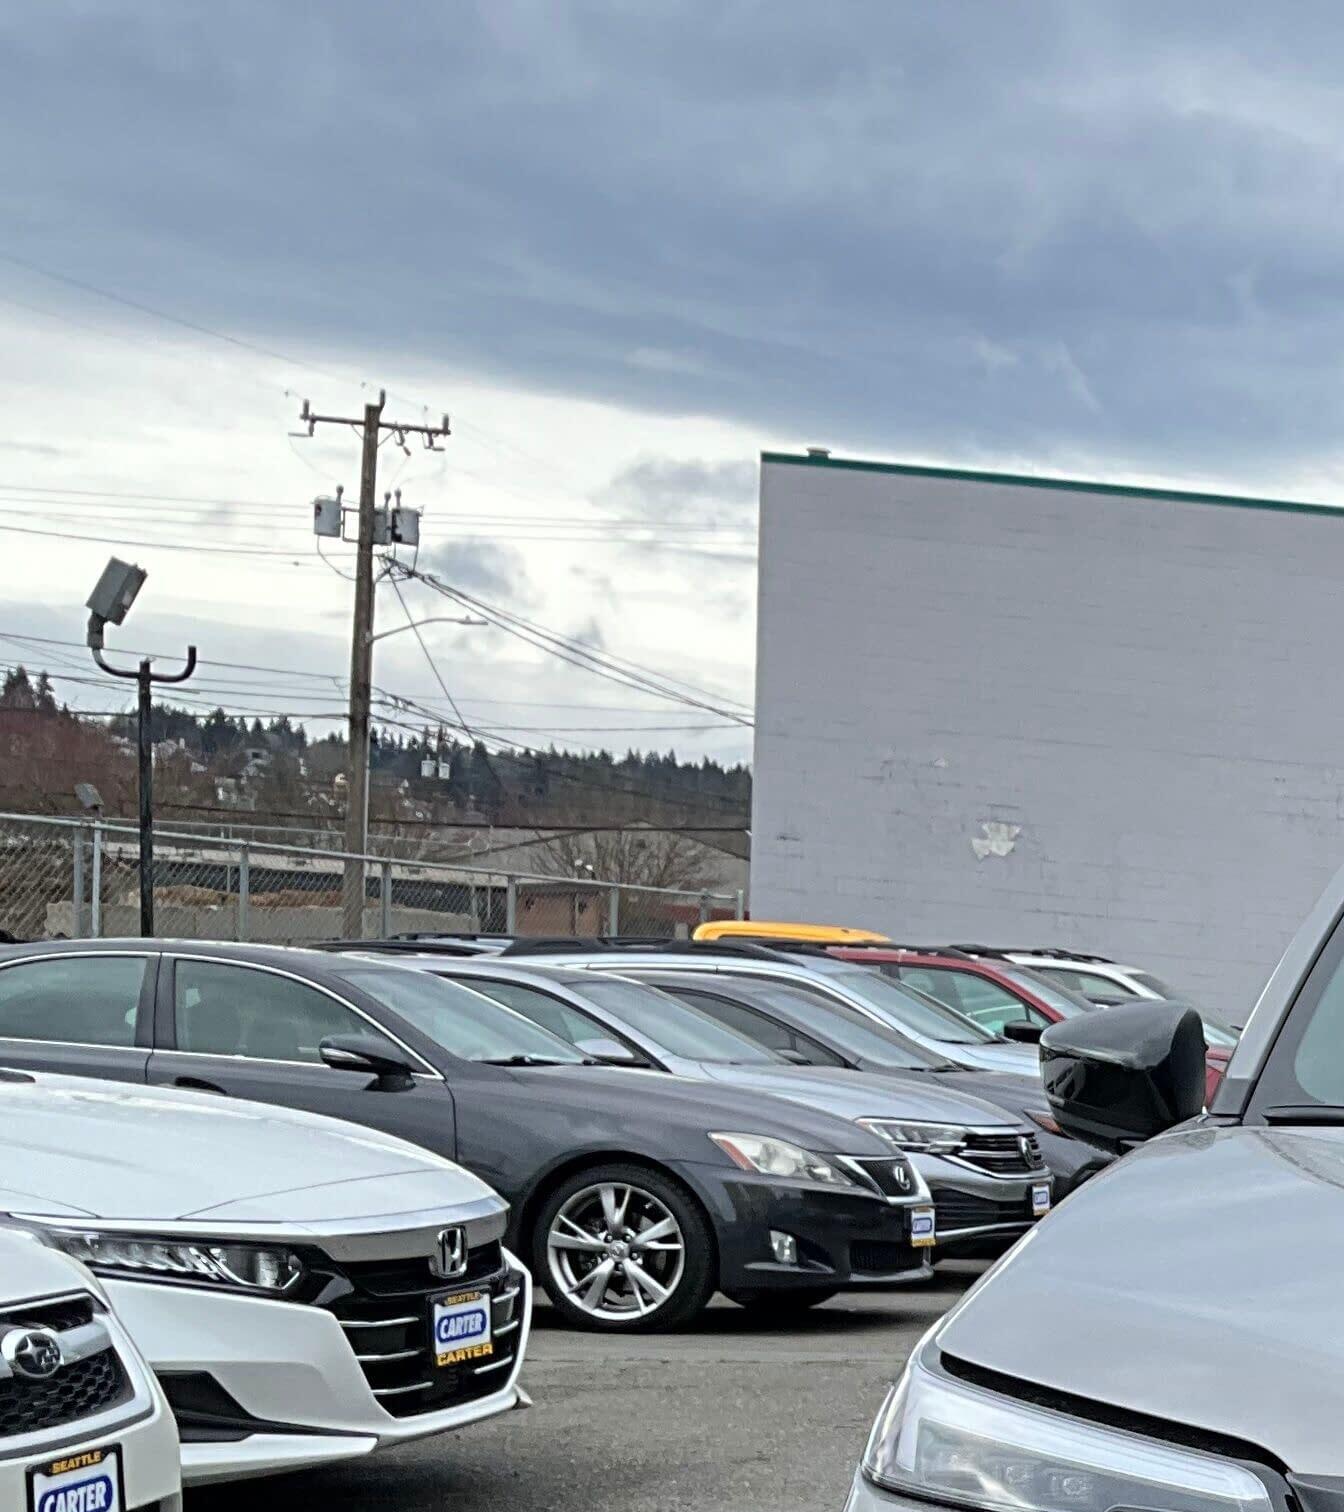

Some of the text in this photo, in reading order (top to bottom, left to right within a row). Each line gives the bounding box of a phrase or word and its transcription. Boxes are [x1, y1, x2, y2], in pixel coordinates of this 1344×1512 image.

[441, 1313, 482, 1338] CARTER
[438, 1344, 493, 1366] CARTER
[52, 1451, 101, 1473] SEATTLE
